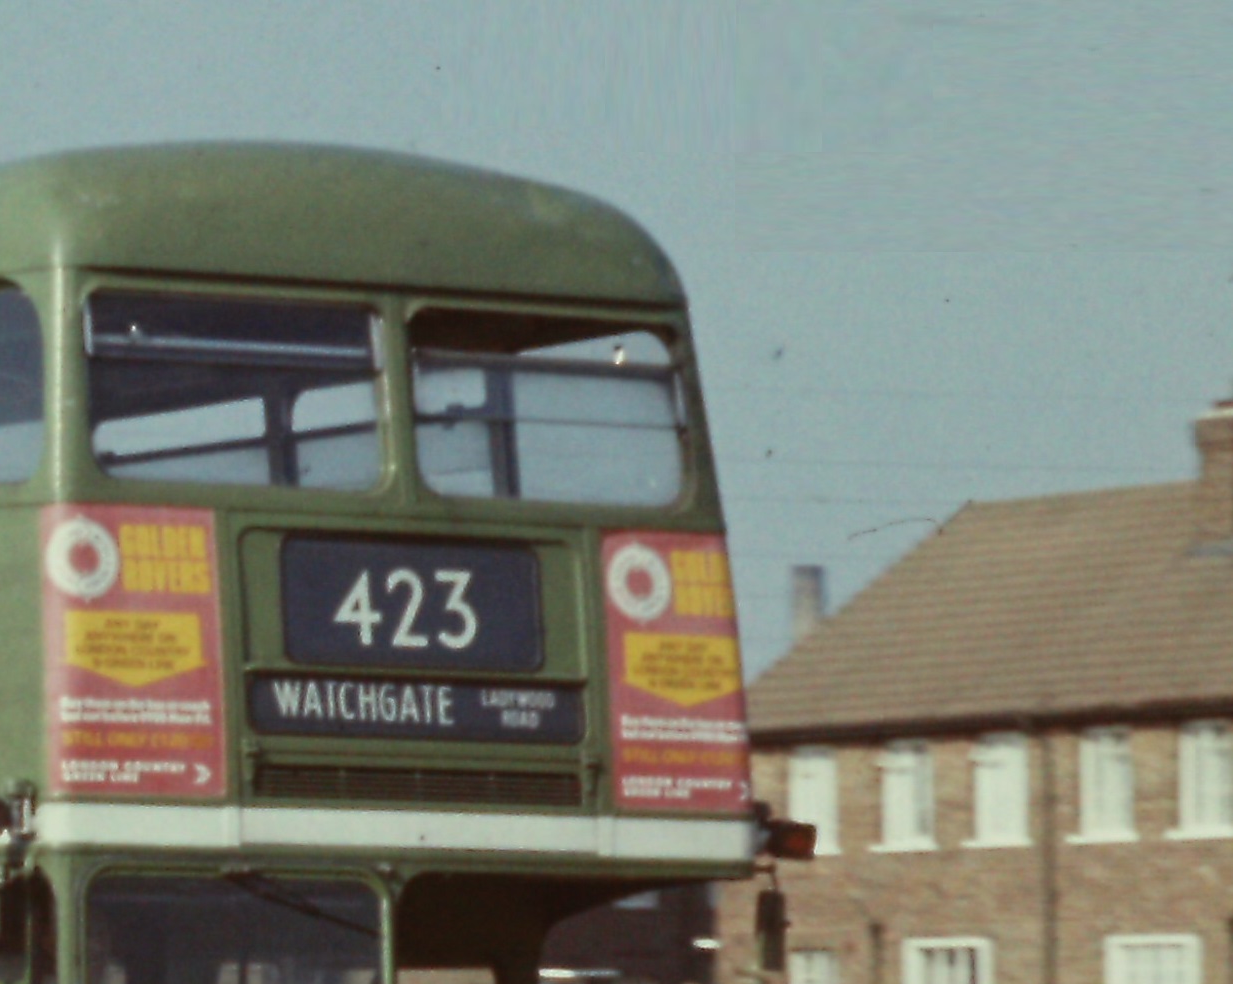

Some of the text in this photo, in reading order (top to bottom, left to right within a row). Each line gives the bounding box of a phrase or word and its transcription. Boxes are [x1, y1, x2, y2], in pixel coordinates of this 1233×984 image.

[333, 568, 478, 650] 423
[274, 680, 455, 727] WATCHGATE
[481, 689, 556, 711] LADYWOOD
[501, 710, 541, 729] ROAD
[61, 760, 186, 774] LONDON COUNTRY
